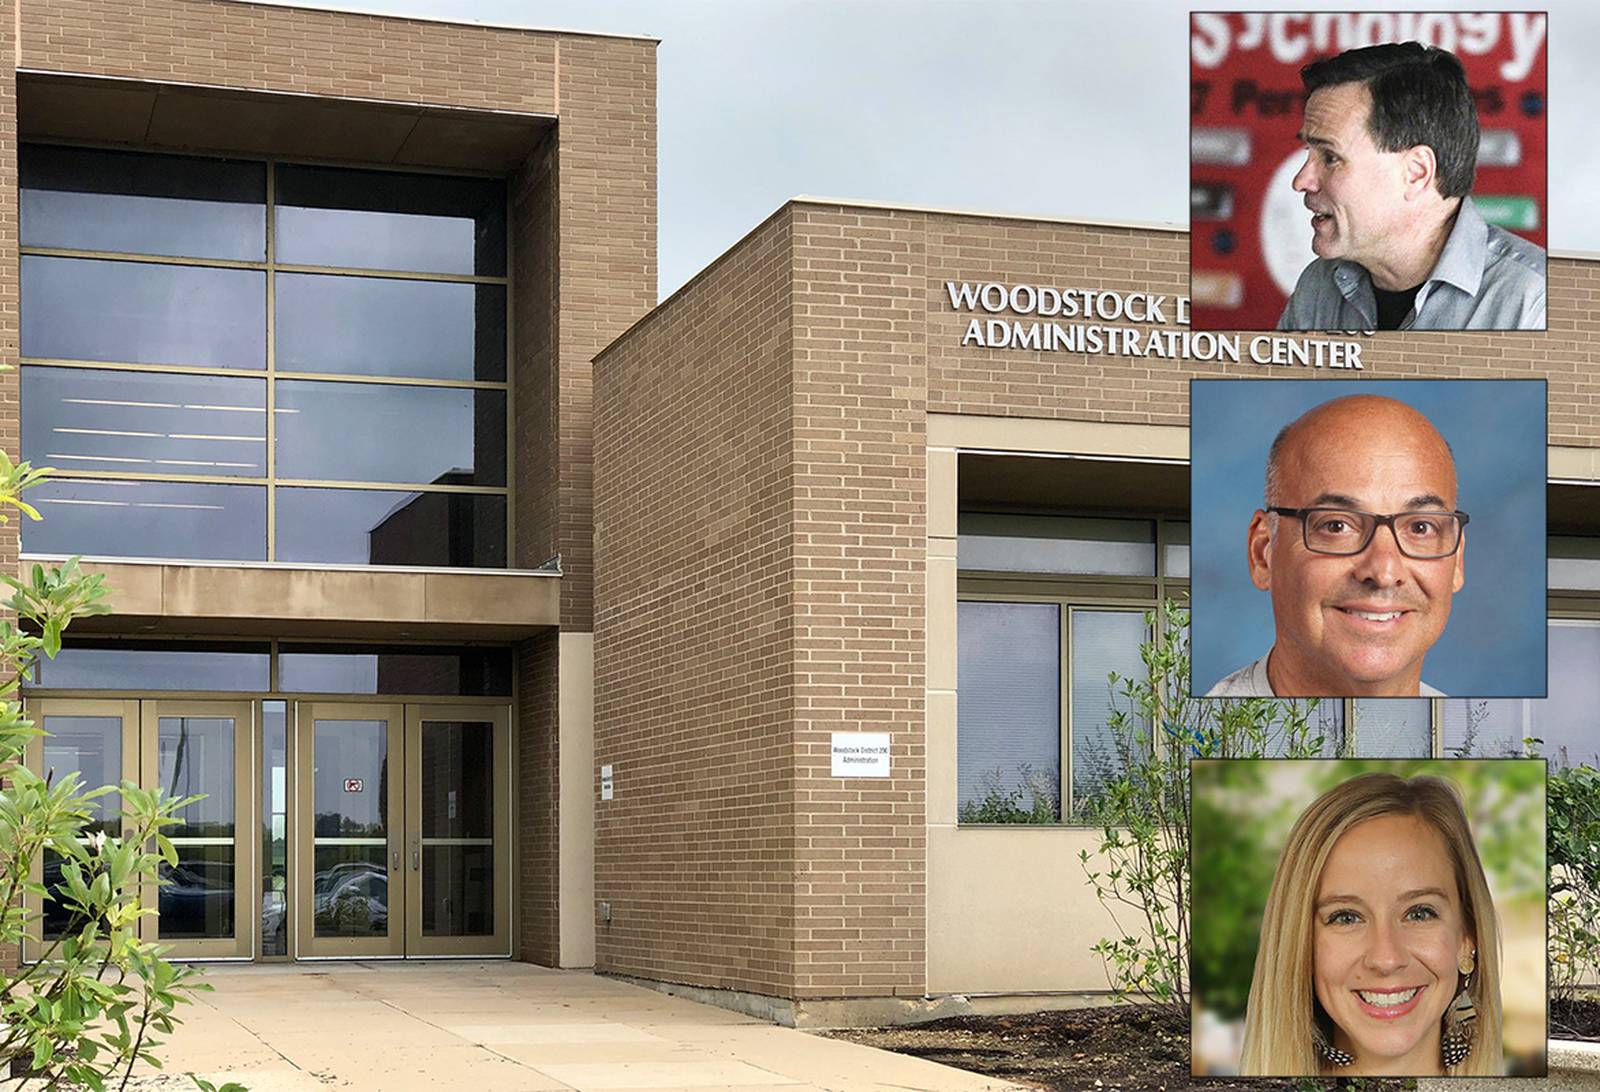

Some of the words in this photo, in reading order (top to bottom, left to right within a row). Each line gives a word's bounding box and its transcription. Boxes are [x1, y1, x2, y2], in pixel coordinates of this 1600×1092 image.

[946, 282, 1166, 322] WOODSTOCK
[962, 319, 1240, 361] ADMINISTRATION
[1249, 335, 1364, 369] CENTER
